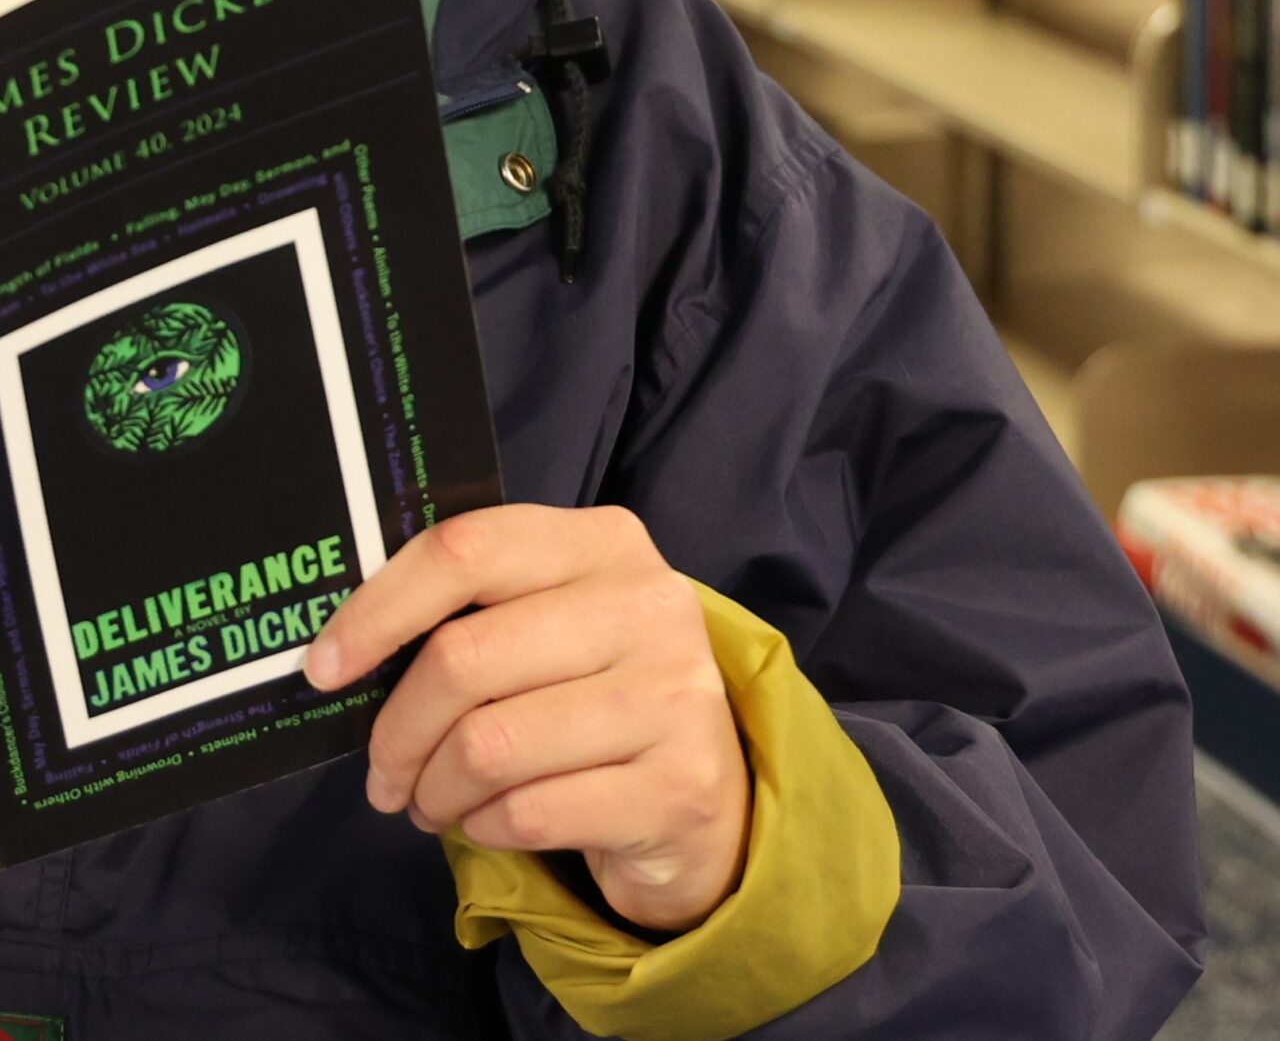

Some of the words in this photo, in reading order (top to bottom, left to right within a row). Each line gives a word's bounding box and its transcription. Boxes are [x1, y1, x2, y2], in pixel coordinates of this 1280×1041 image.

[23, 43, 221, 157] REVIEW
[19, 150, 126, 211] VOLUME
[180, 102, 242, 143] 2024
[354, 144, 370, 184] Other
[32, 260, 54, 278] of
[50, 242, 101, 266] Fields
[184, 192, 218, 212] May
[320, 142, 355, 158] and
[362, 182, 380, 232] Poems
[372, 246, 394, 298] Alnilam
[386, 312, 400, 332] To
[390, 328, 404, 356] the
[394, 352, 412, 394] White
[402, 392, 416, 420] Sea
[410, 434, 428, 486] Helmets
[72, 535, 347, 660] DELIVERANCE
[186, 614, 229, 633] NOVEL
[234, 604, 251, 618] BY
[90, 635, 212, 707] JAMES
[302, 700, 345, 723] White
[342, 692, 370, 708] the
[272, 716, 304, 728] Sea
[0, 712, 26, 796] Buckdancer's
[198, 728, 260, 754] Helmets
[114, 752, 184, 784] Drowning
[32, 786, 85, 810] Others
[80, 775, 118, 798] with
